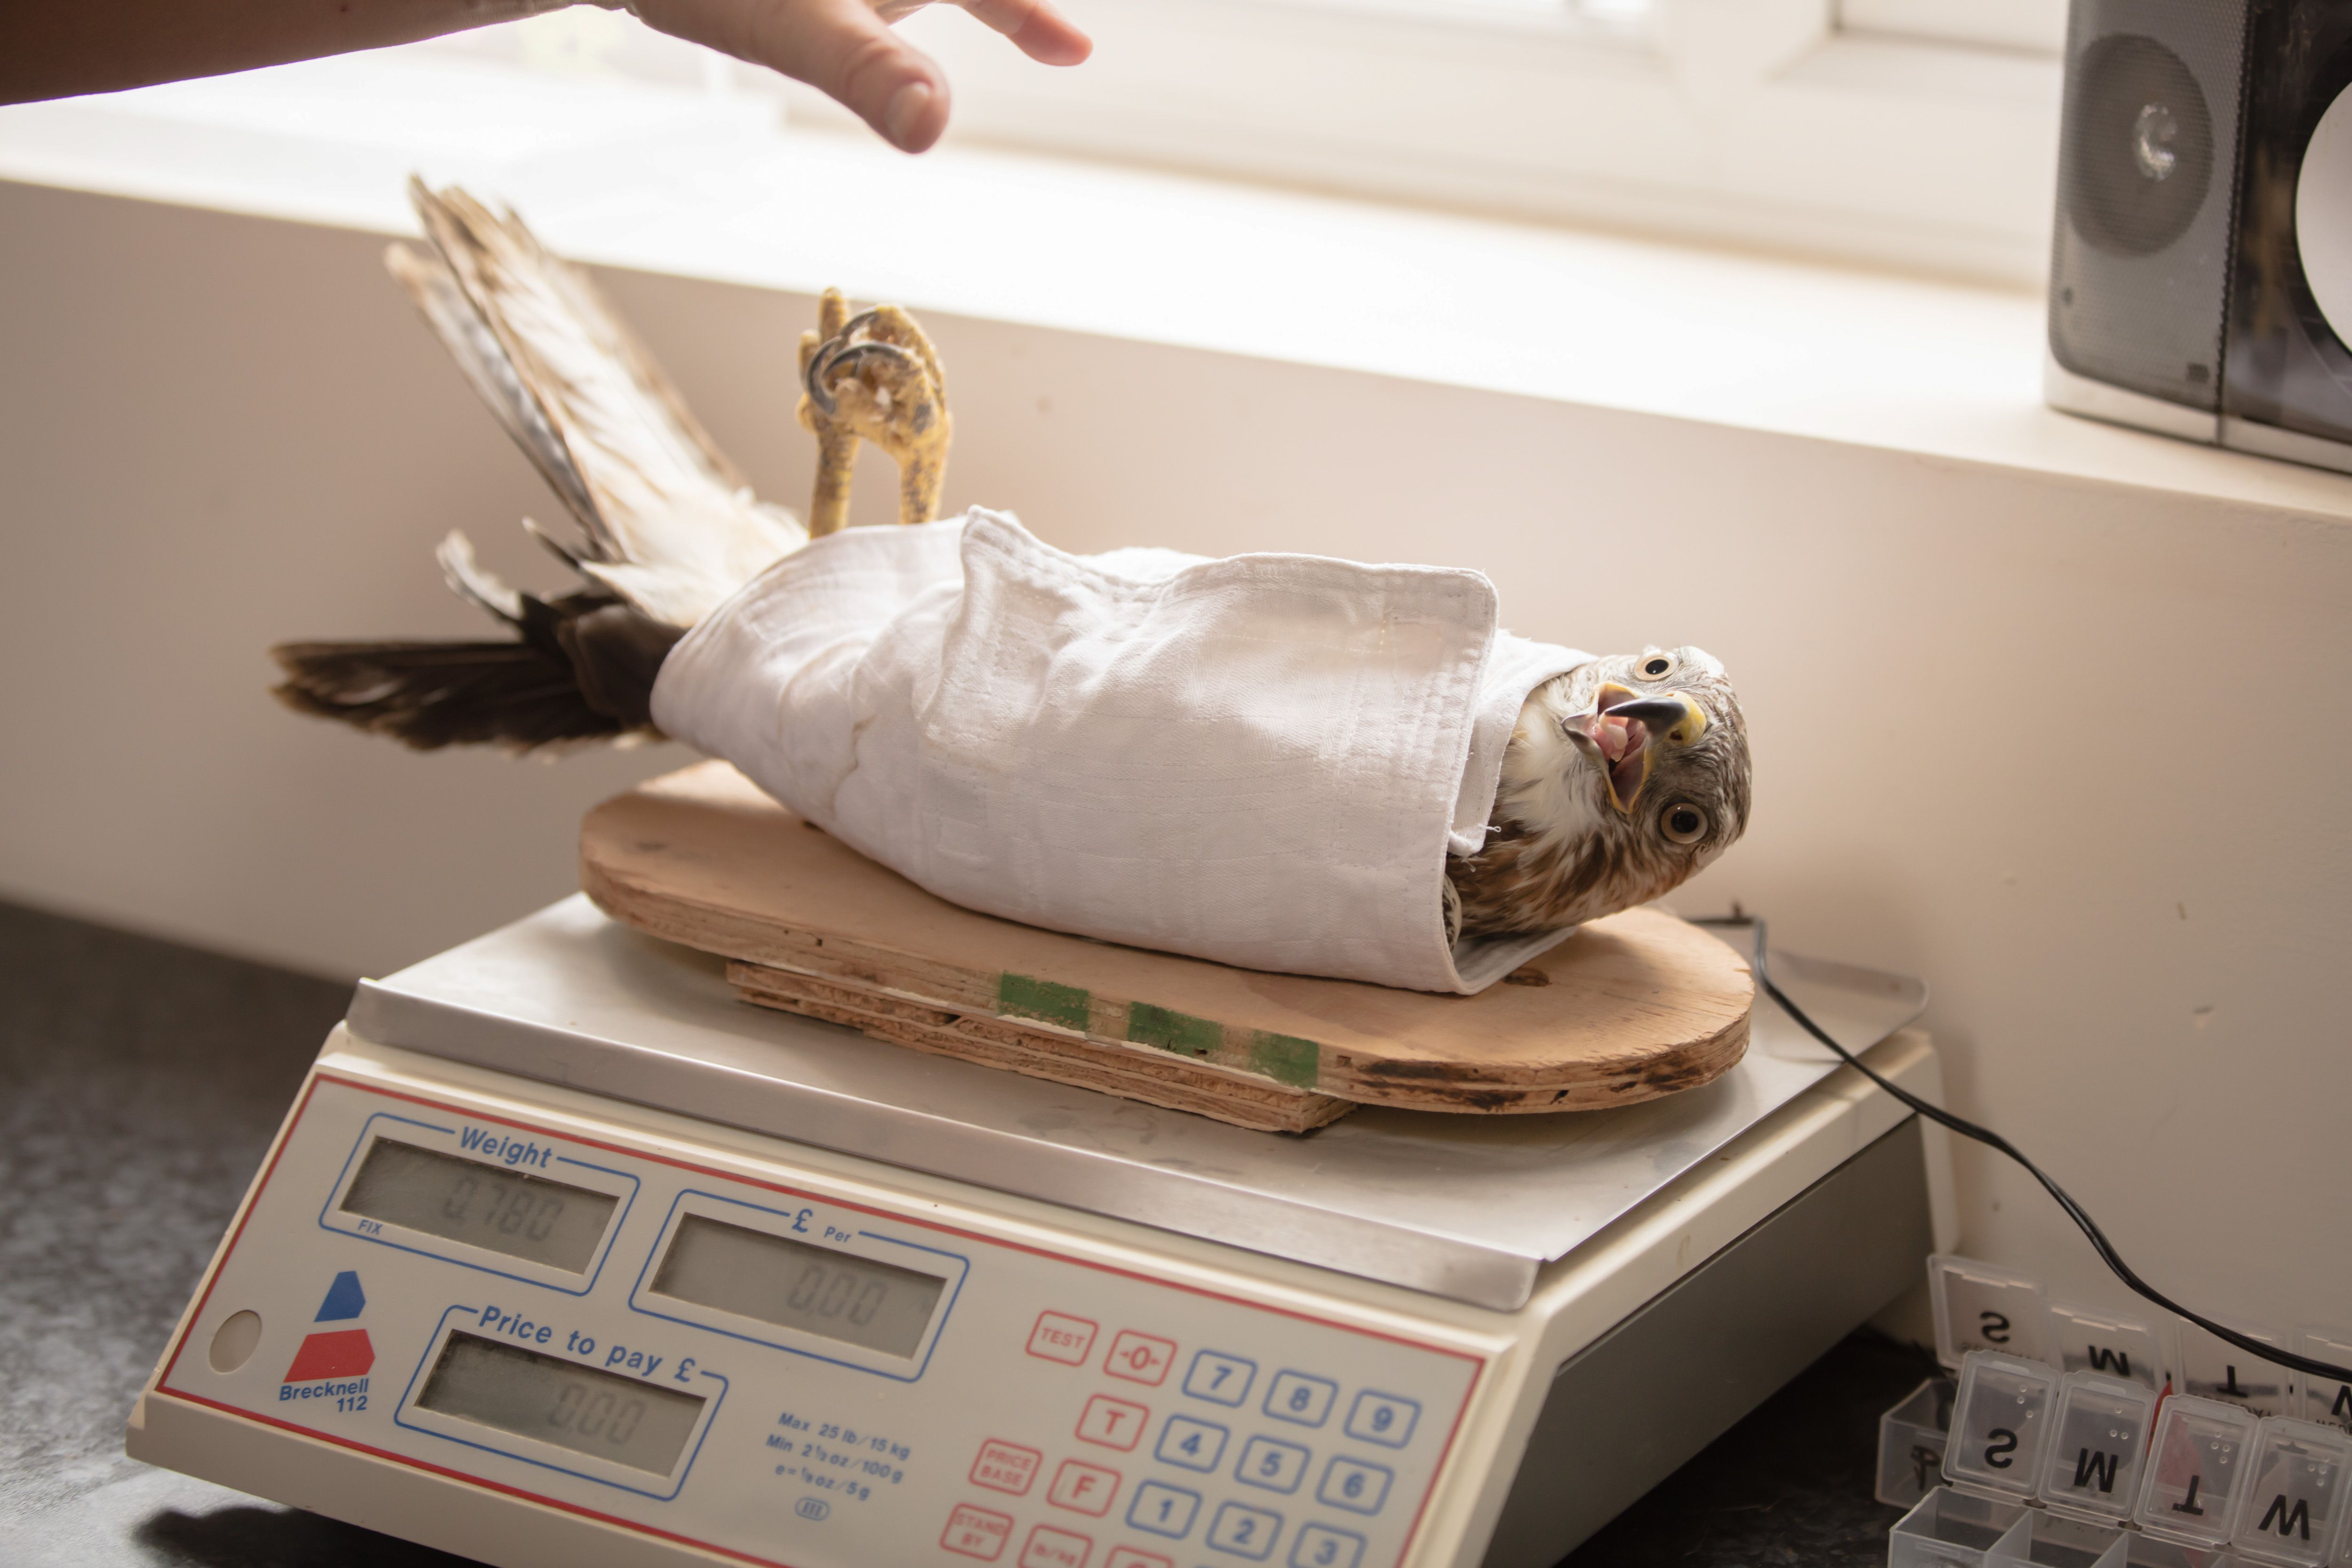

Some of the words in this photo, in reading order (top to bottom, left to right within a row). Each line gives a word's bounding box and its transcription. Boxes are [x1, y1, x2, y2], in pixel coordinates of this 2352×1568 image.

[461, 1126, 552, 1168] Weight
[358, 1219, 383, 1235] FIX
[792, 1209, 813, 1233] £
[824, 1226, 851, 1244] Per
[478, 1305, 551, 1344] Price
[569, 1330, 595, 1355] to
[606, 1345, 662, 1377] pay
[674, 1357, 696, 1383] £
[1041, 1327, 1085, 1349] TEST
[278, 1378, 369, 1401] Brecknell
[1211, 1367, 1233, 1390] 7
[336, 1395, 368, 1413] 112
[1288, 1386, 1311, 1412] 8
[778, 1412, 810, 1432] Max
[1105, 1410, 1126, 1435] T
[1371, 1406, 1394, 1433] 9
[765, 1434, 794, 1452] Min
[1180, 1433, 1202, 1457] 4
[986, 1449, 1033, 1471] PRICE
[1259, 1451, 1283, 1478] 5
[980, 1465, 1024, 1486] BASE
[1072, 1475, 1097, 1499] F
[1342, 1472, 1365, 1499] 6
[1159, 1499, 1174, 1523] 1
[1233, 1518, 1256, 1545] 2
[1315, 1540, 1339, 1566] 3
